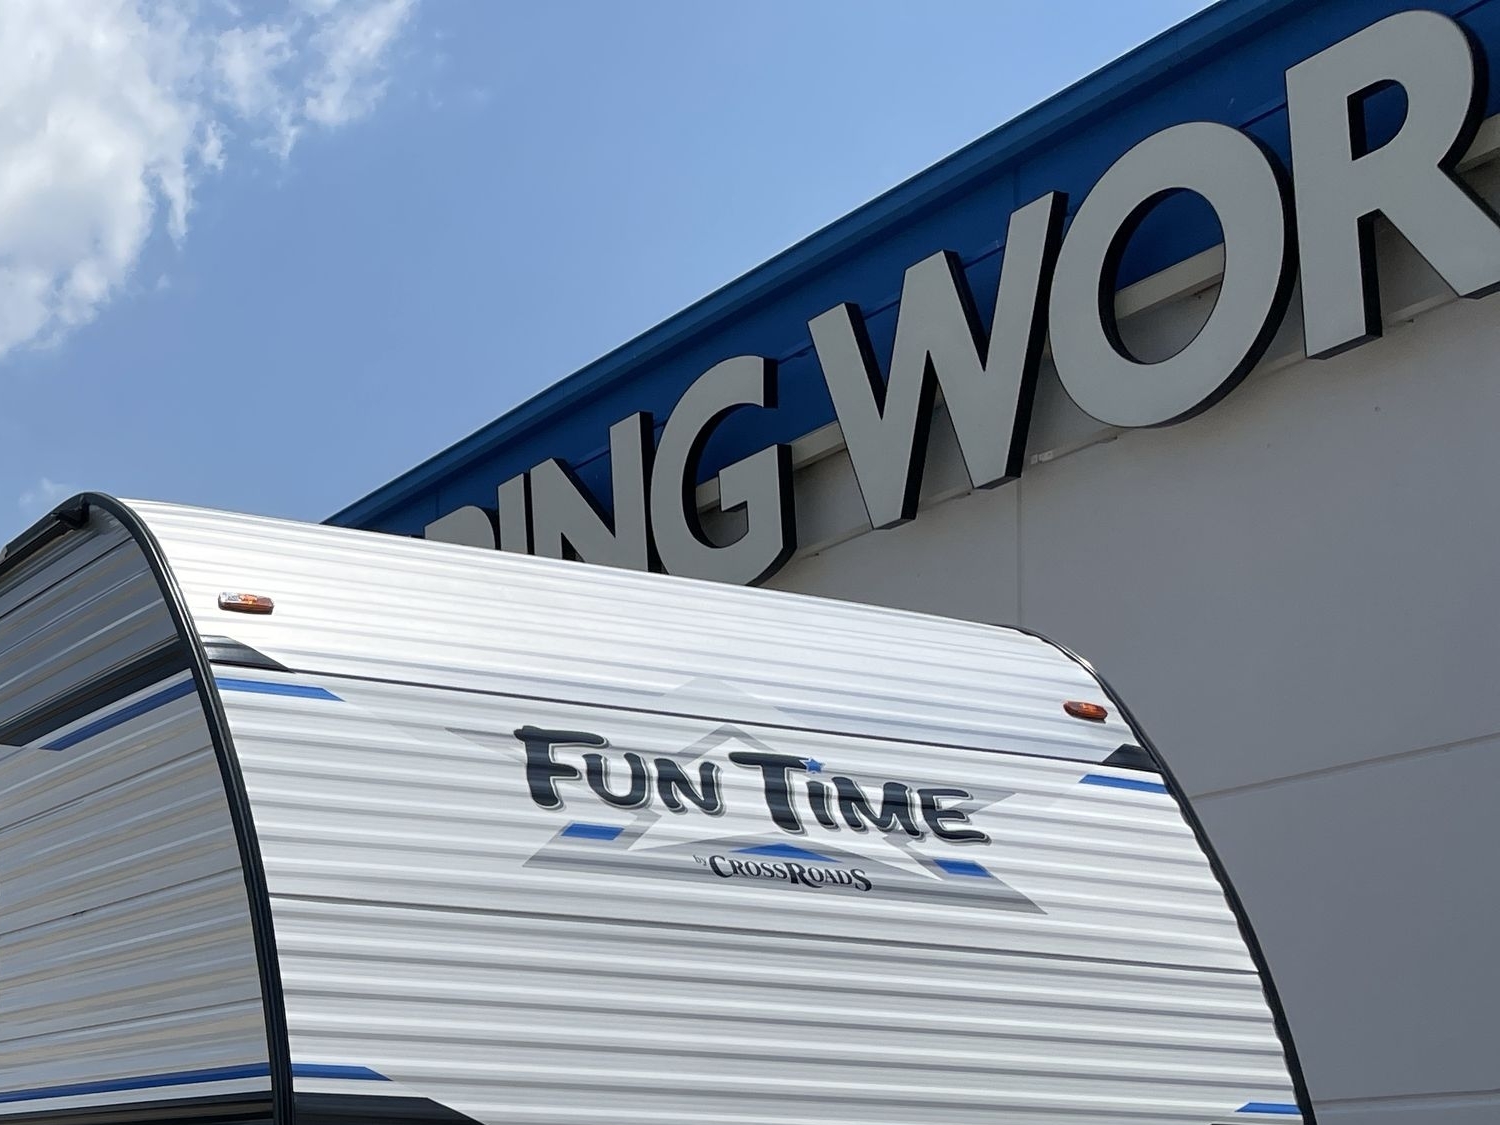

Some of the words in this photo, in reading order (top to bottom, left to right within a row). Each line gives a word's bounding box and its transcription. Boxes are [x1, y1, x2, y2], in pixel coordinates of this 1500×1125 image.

[808, 10, 1500, 530] WOR
[513, 726, 722, 815] FUN
[728, 751, 990, 844] TIME
[693, 854, 707, 867] by
